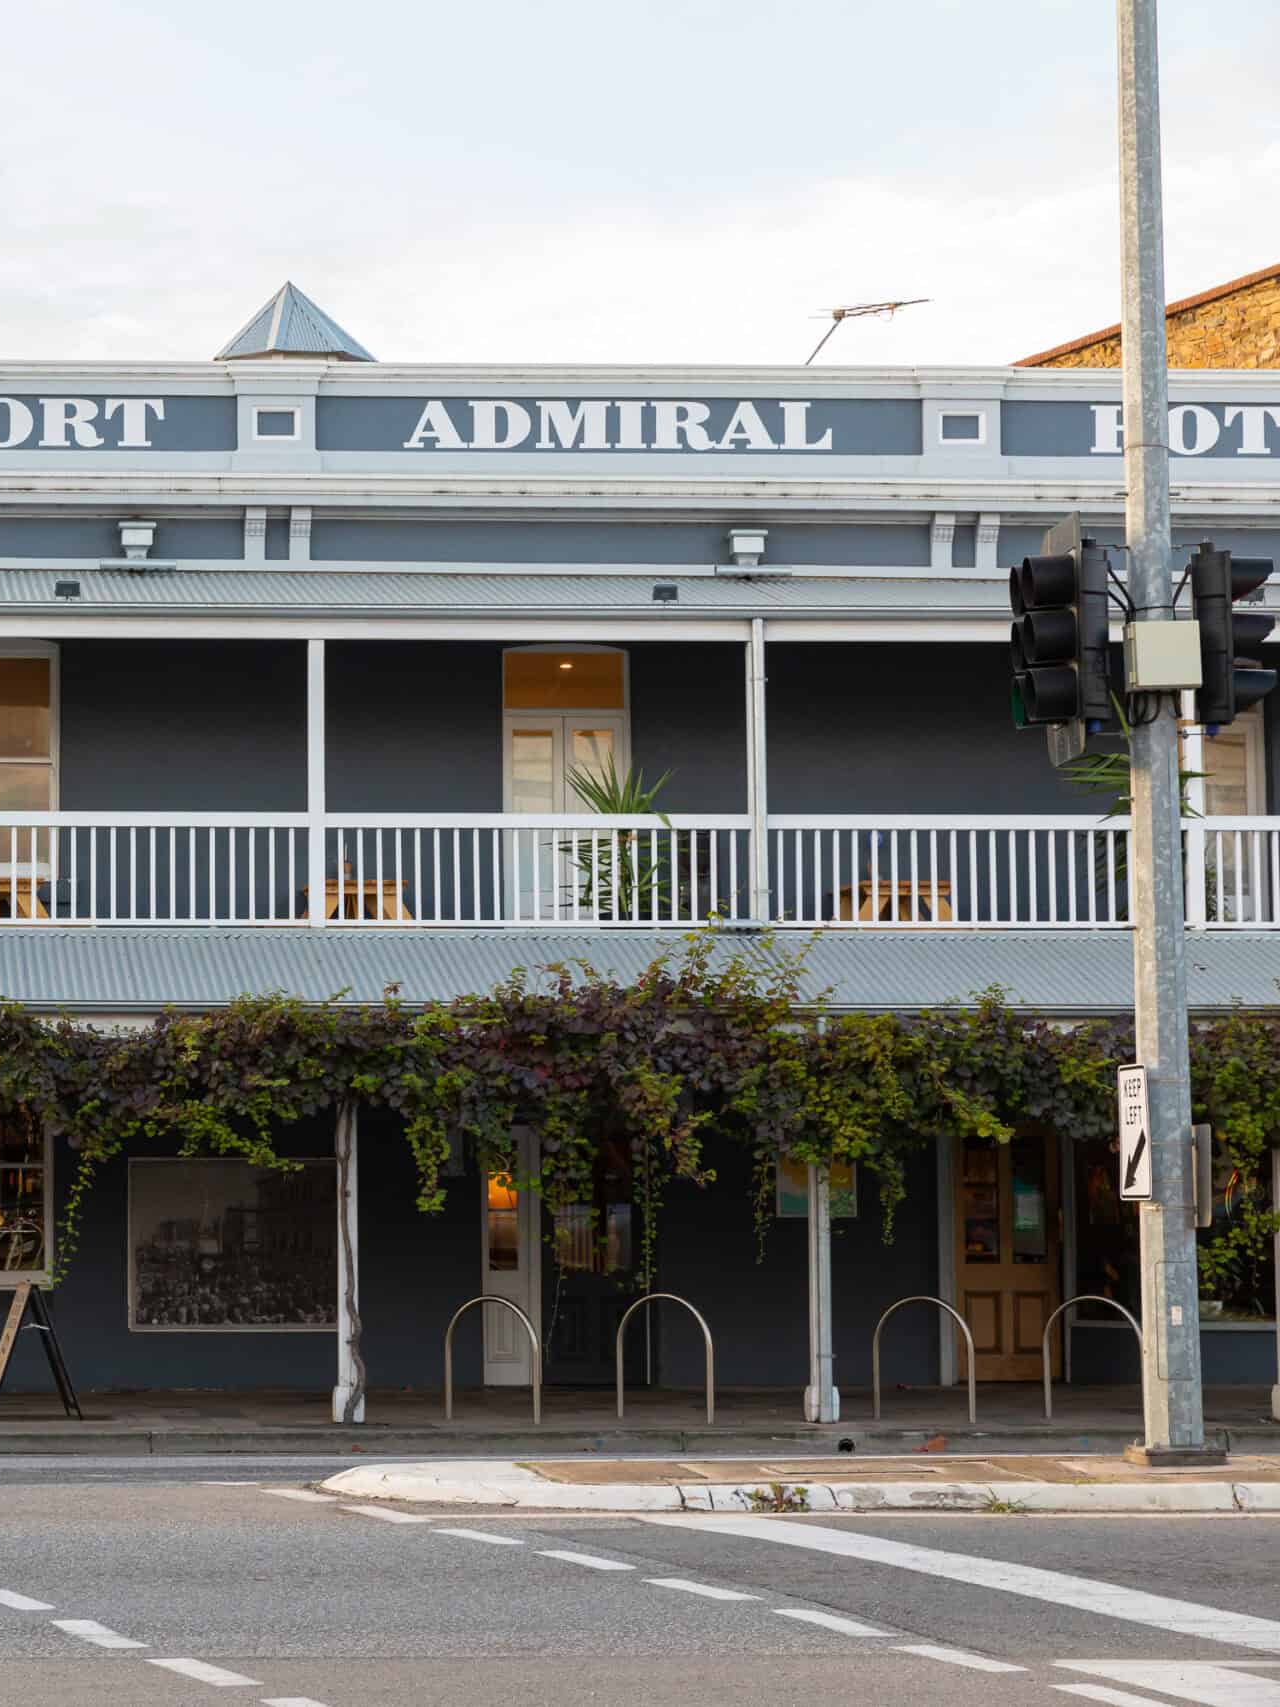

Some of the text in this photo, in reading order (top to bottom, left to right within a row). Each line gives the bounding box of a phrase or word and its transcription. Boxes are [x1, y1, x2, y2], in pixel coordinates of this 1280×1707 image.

[403, 400, 833, 450] ADMIRAL
[1124, 1077, 1142, 1098] KEEP
[1125, 1105, 1142, 1126] LEFT
